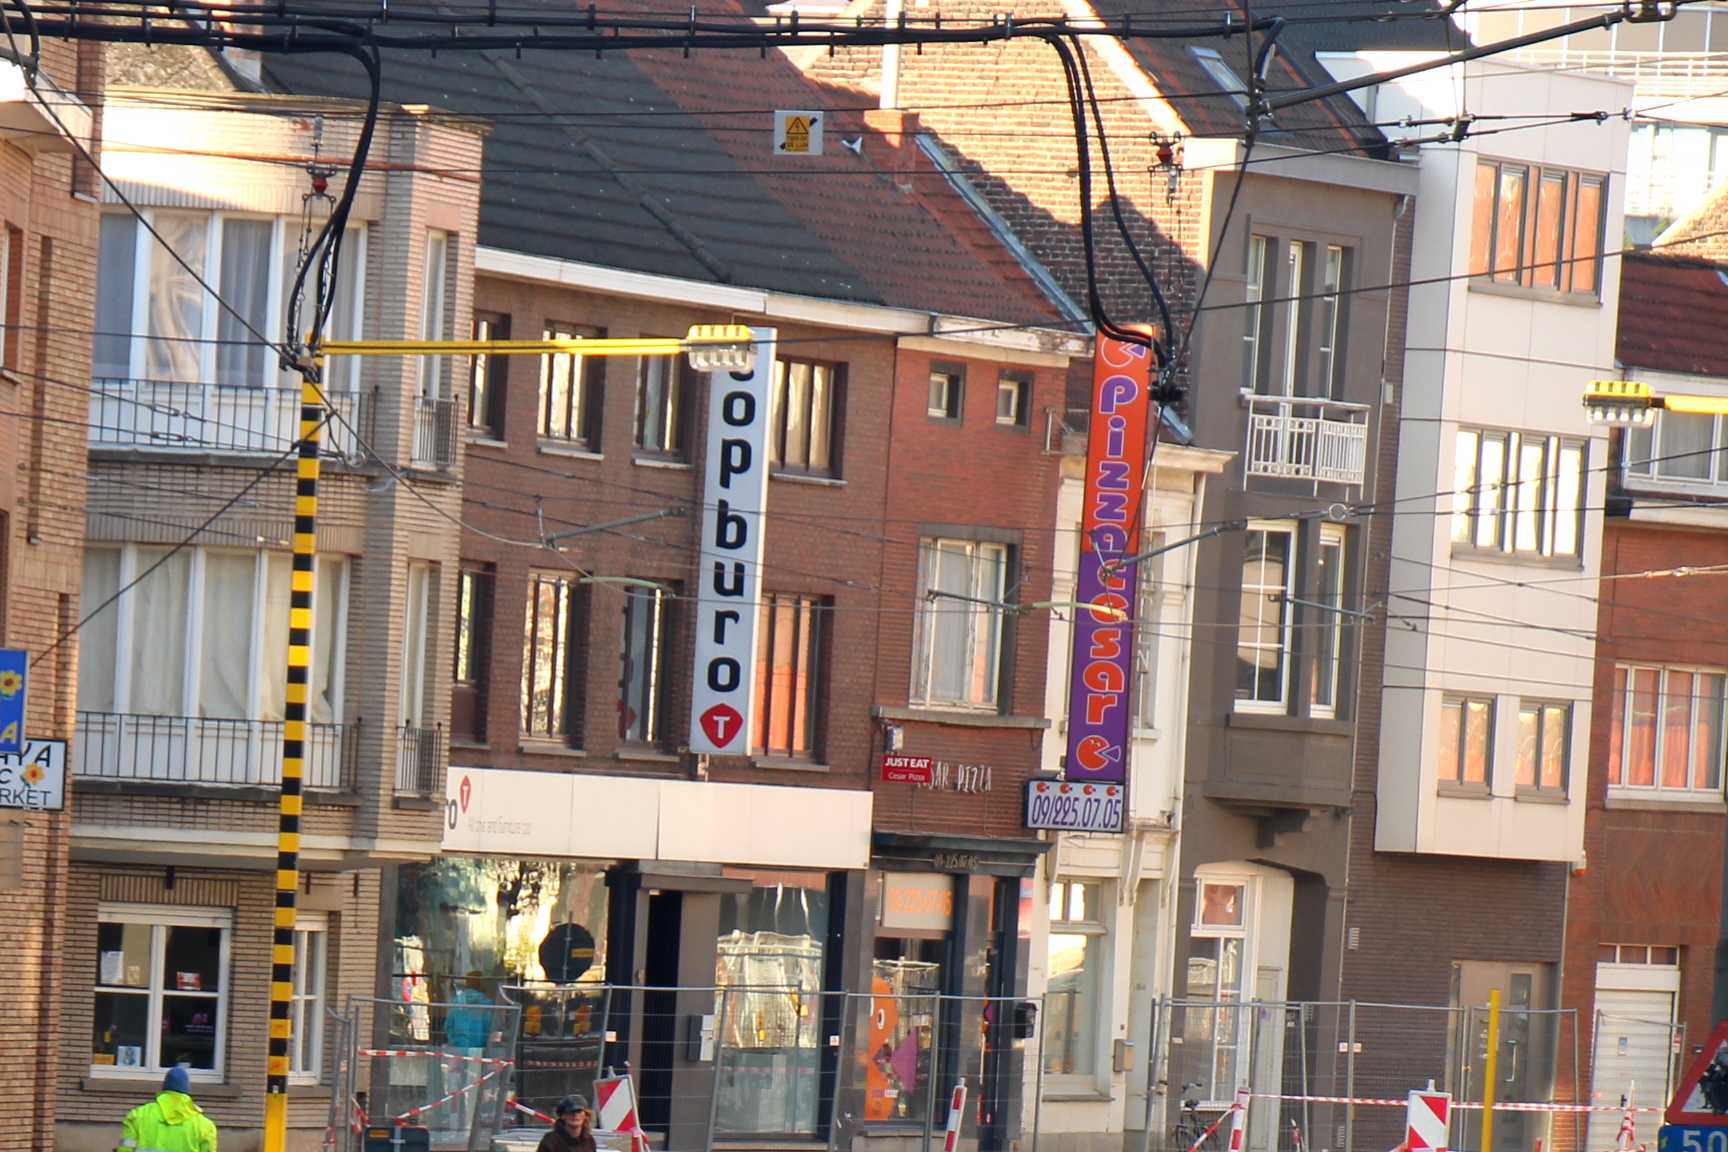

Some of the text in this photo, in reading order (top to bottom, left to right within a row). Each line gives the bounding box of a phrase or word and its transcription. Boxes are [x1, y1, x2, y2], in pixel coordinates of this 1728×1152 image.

[707, 369, 756, 693] opburo
[885, 757, 929, 768] JUST EAT
